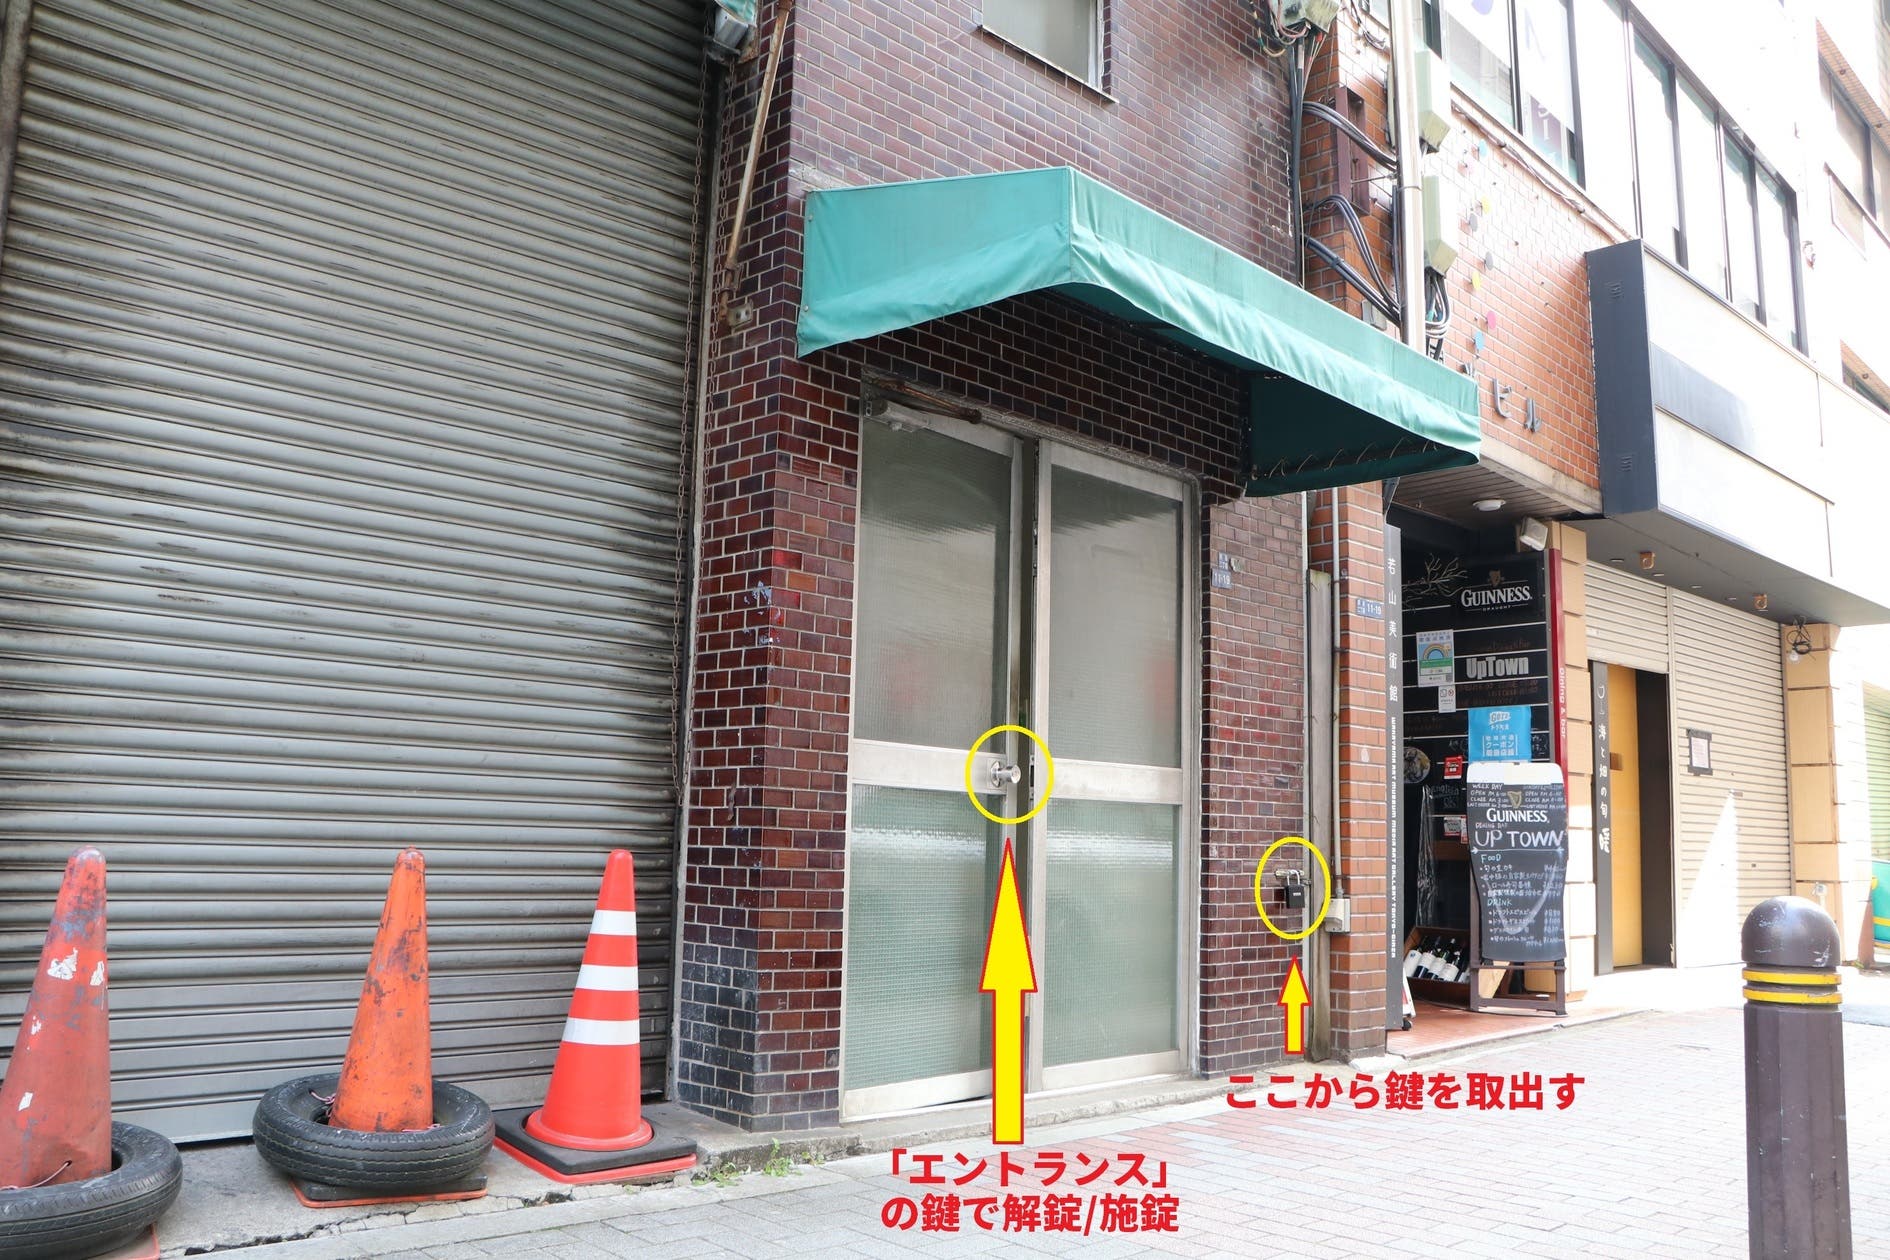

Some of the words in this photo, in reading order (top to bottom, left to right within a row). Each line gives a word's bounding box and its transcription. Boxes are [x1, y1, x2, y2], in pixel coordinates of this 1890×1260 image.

[1461, 586, 1531, 607] GUINNESS
[1366, 602, 1382, 615] 11-19
[1387, 558, 1398, 702] 若山美術館
[1466, 656, 1529, 679] UpTown
[1485, 741, 1515, 749] クーポン
[1486, 808, 1548, 823] GUINNESS
[1475, 830, 1503, 848] UP
[1506, 830, 1564, 848] TOWN
[1487, 898, 1513, 906] DRINK
